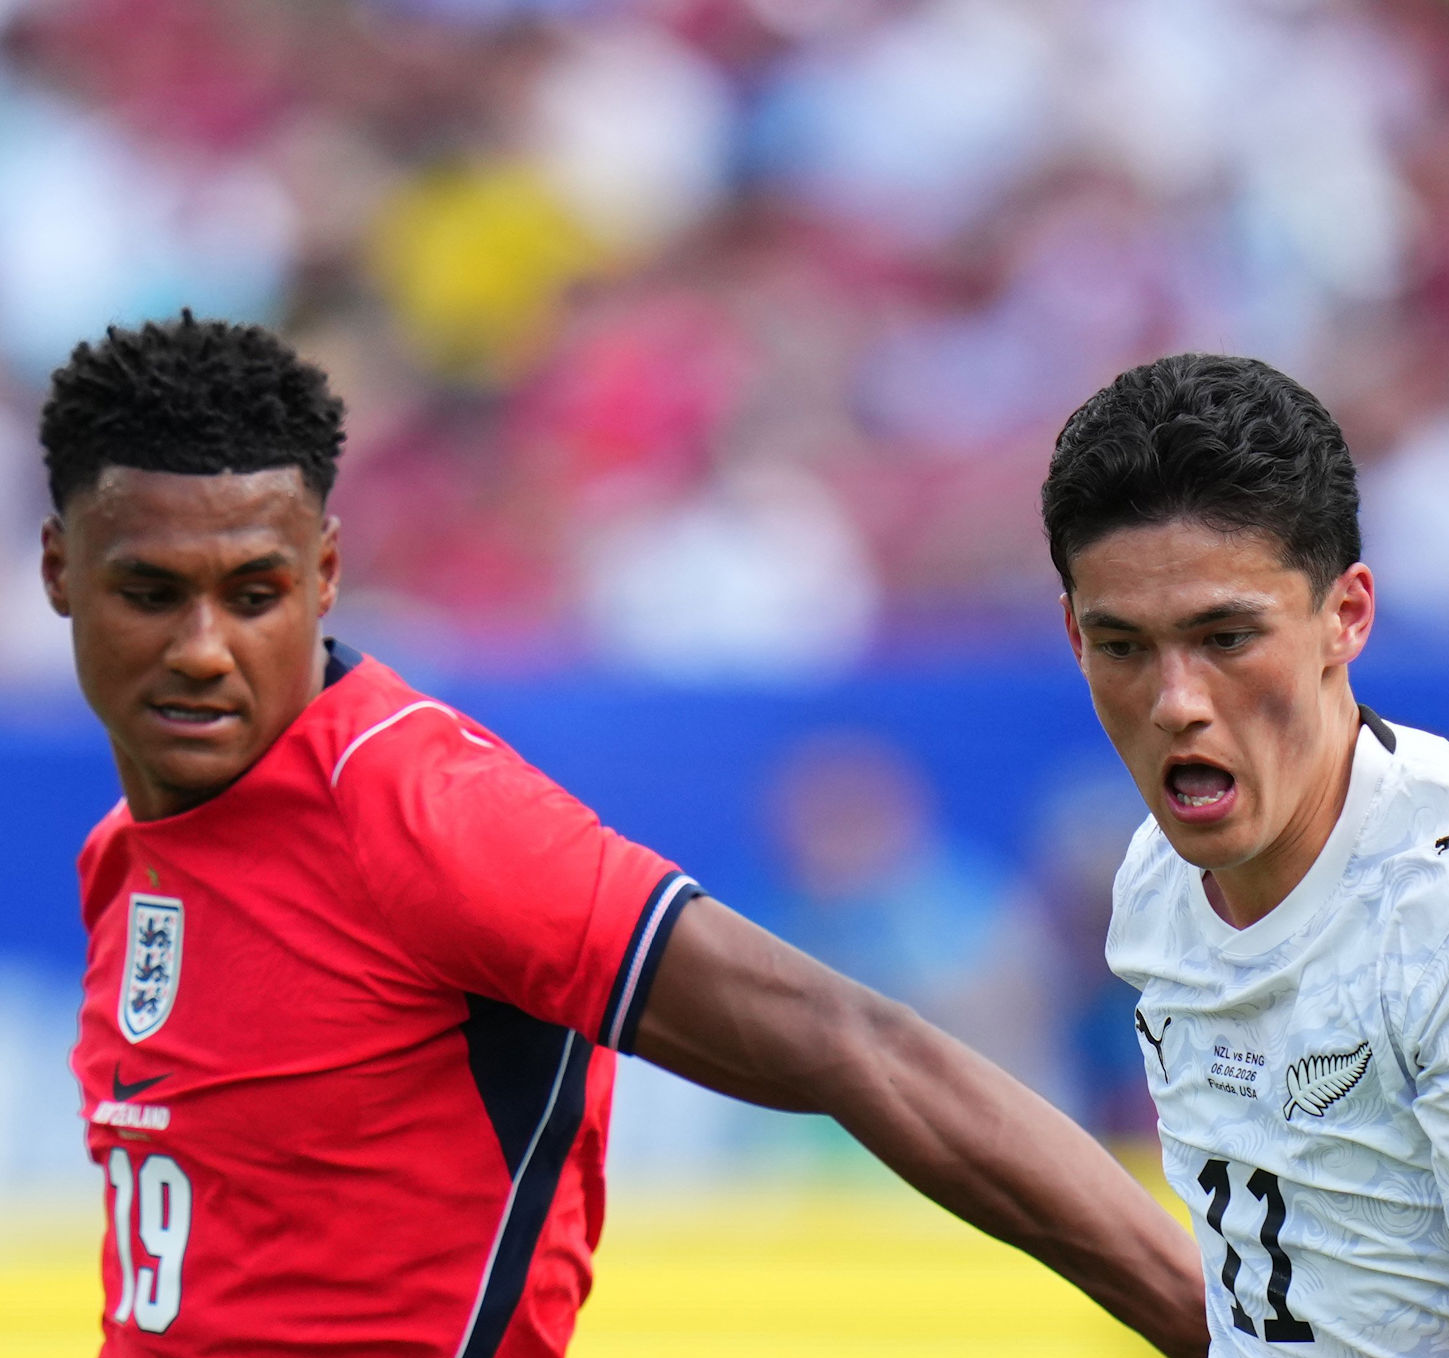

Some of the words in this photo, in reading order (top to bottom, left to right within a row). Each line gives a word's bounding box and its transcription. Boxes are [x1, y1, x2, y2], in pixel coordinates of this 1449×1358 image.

[1214, 1045, 1230, 1059] NZL
[1233, 1052, 1243, 1062] vs
[1245, 1052, 1265, 1067] ENG
[1211, 1063, 1257, 1081] 06.06.2026
[1239, 1086, 1258, 1100] USA
[108, 1147, 192, 1334] 19
[1197, 1158, 1316, 1343] 11
